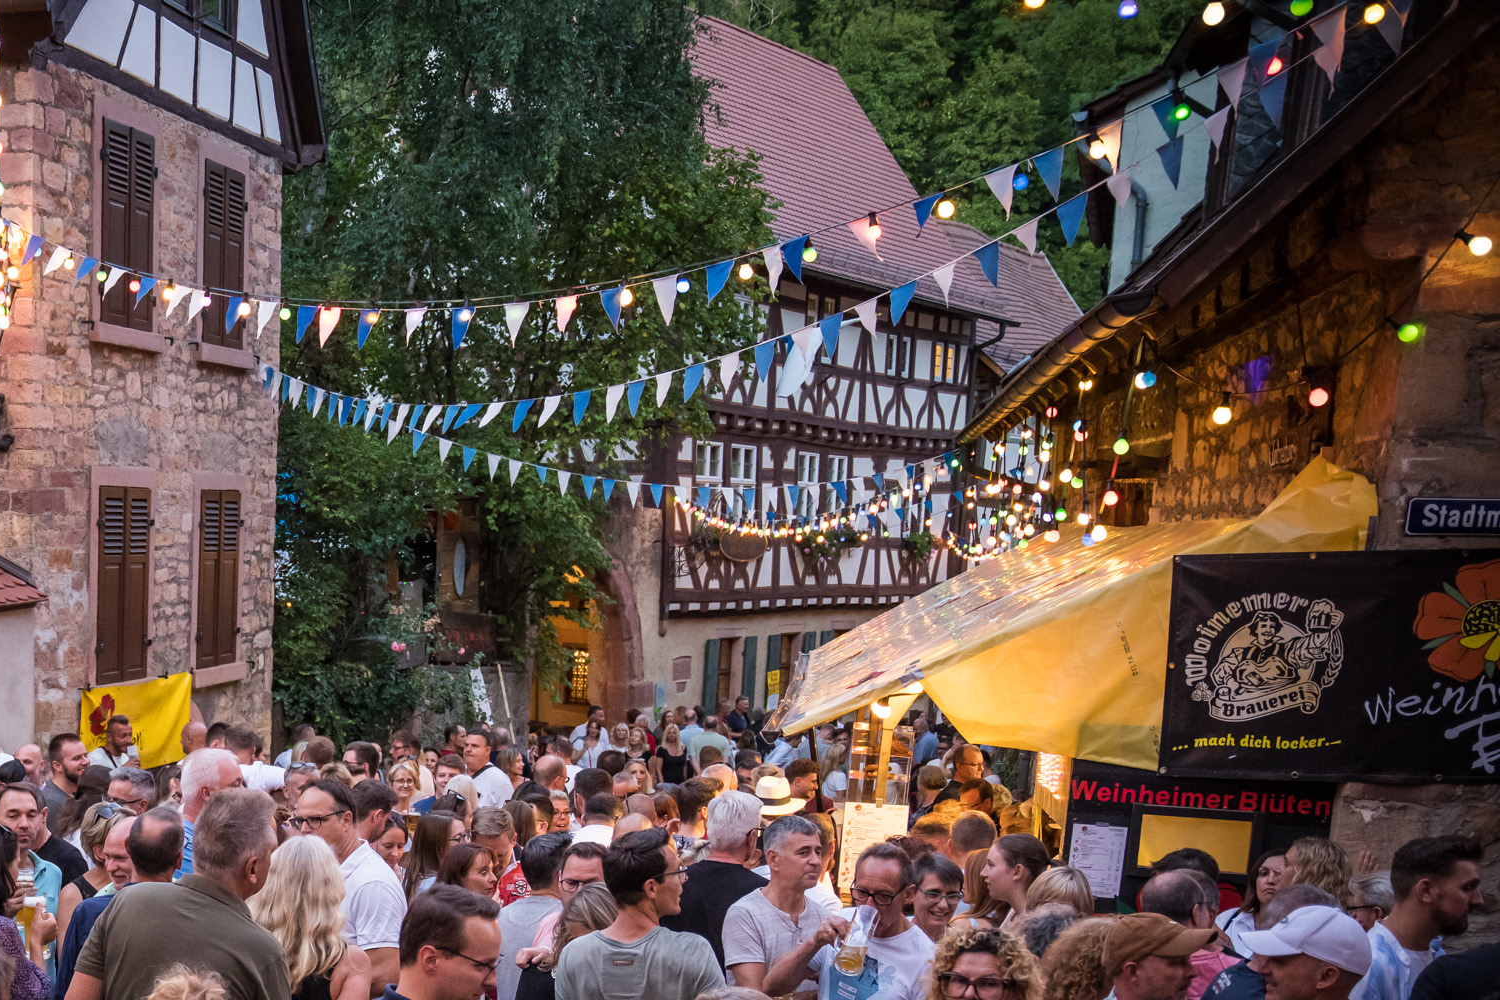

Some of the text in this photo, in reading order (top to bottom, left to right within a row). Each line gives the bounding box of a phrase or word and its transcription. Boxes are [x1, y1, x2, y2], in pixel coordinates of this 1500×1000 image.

[1185, 592, 1309, 687] Woinemer
[1222, 686, 1306, 717] Brauerei
[1364, 675, 1500, 725] Weinh
[1194, 733, 1236, 748] mach
[1239, 734, 1271, 749] dich
[1071, 779, 1332, 816] Weinheimer Blüten
